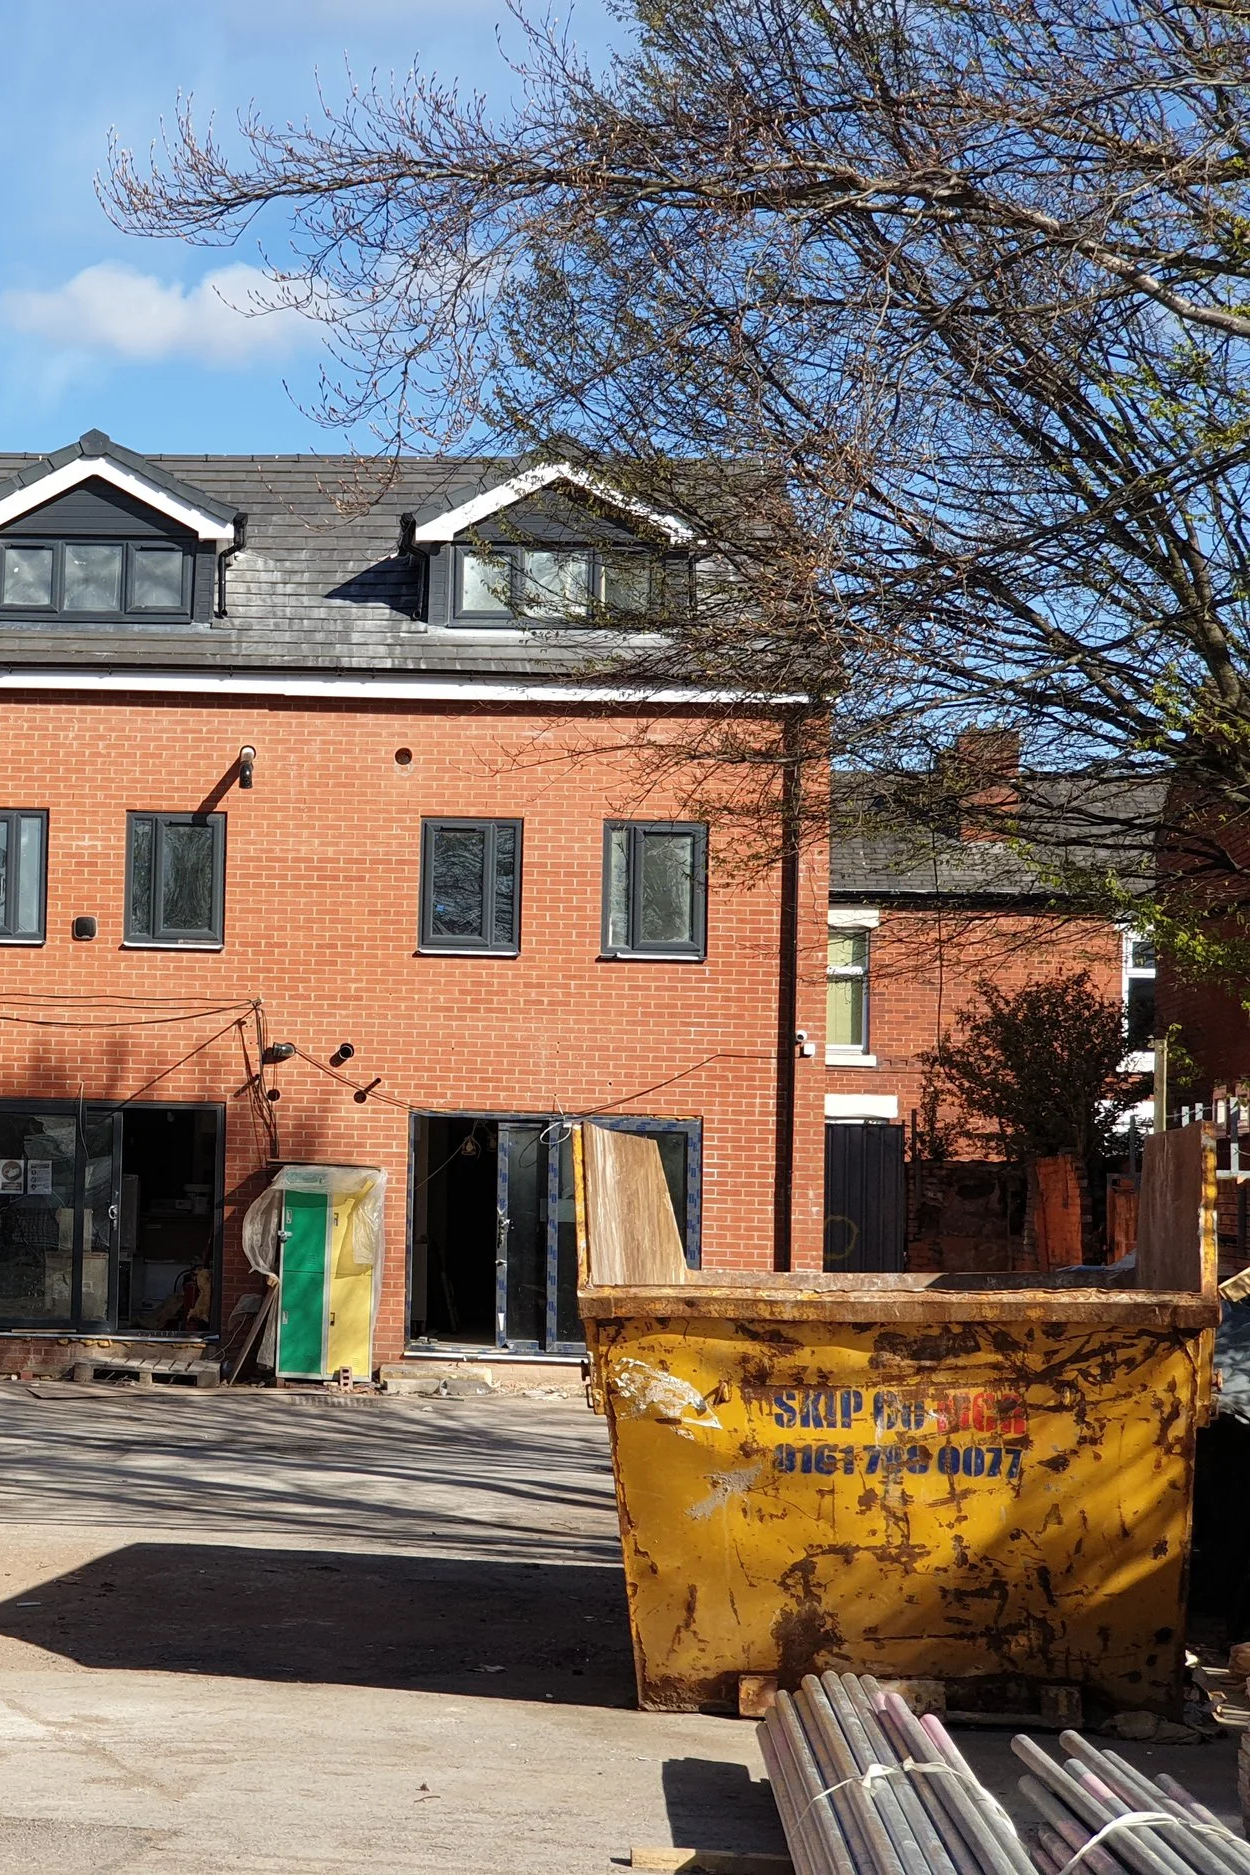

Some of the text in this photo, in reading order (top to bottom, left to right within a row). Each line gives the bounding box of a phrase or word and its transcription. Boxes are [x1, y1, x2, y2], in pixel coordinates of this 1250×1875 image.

[773, 1389, 863, 1430] SKIP
[773, 1443, 855, 1476] 0161
[937, 1445, 1023, 1479] 0077
